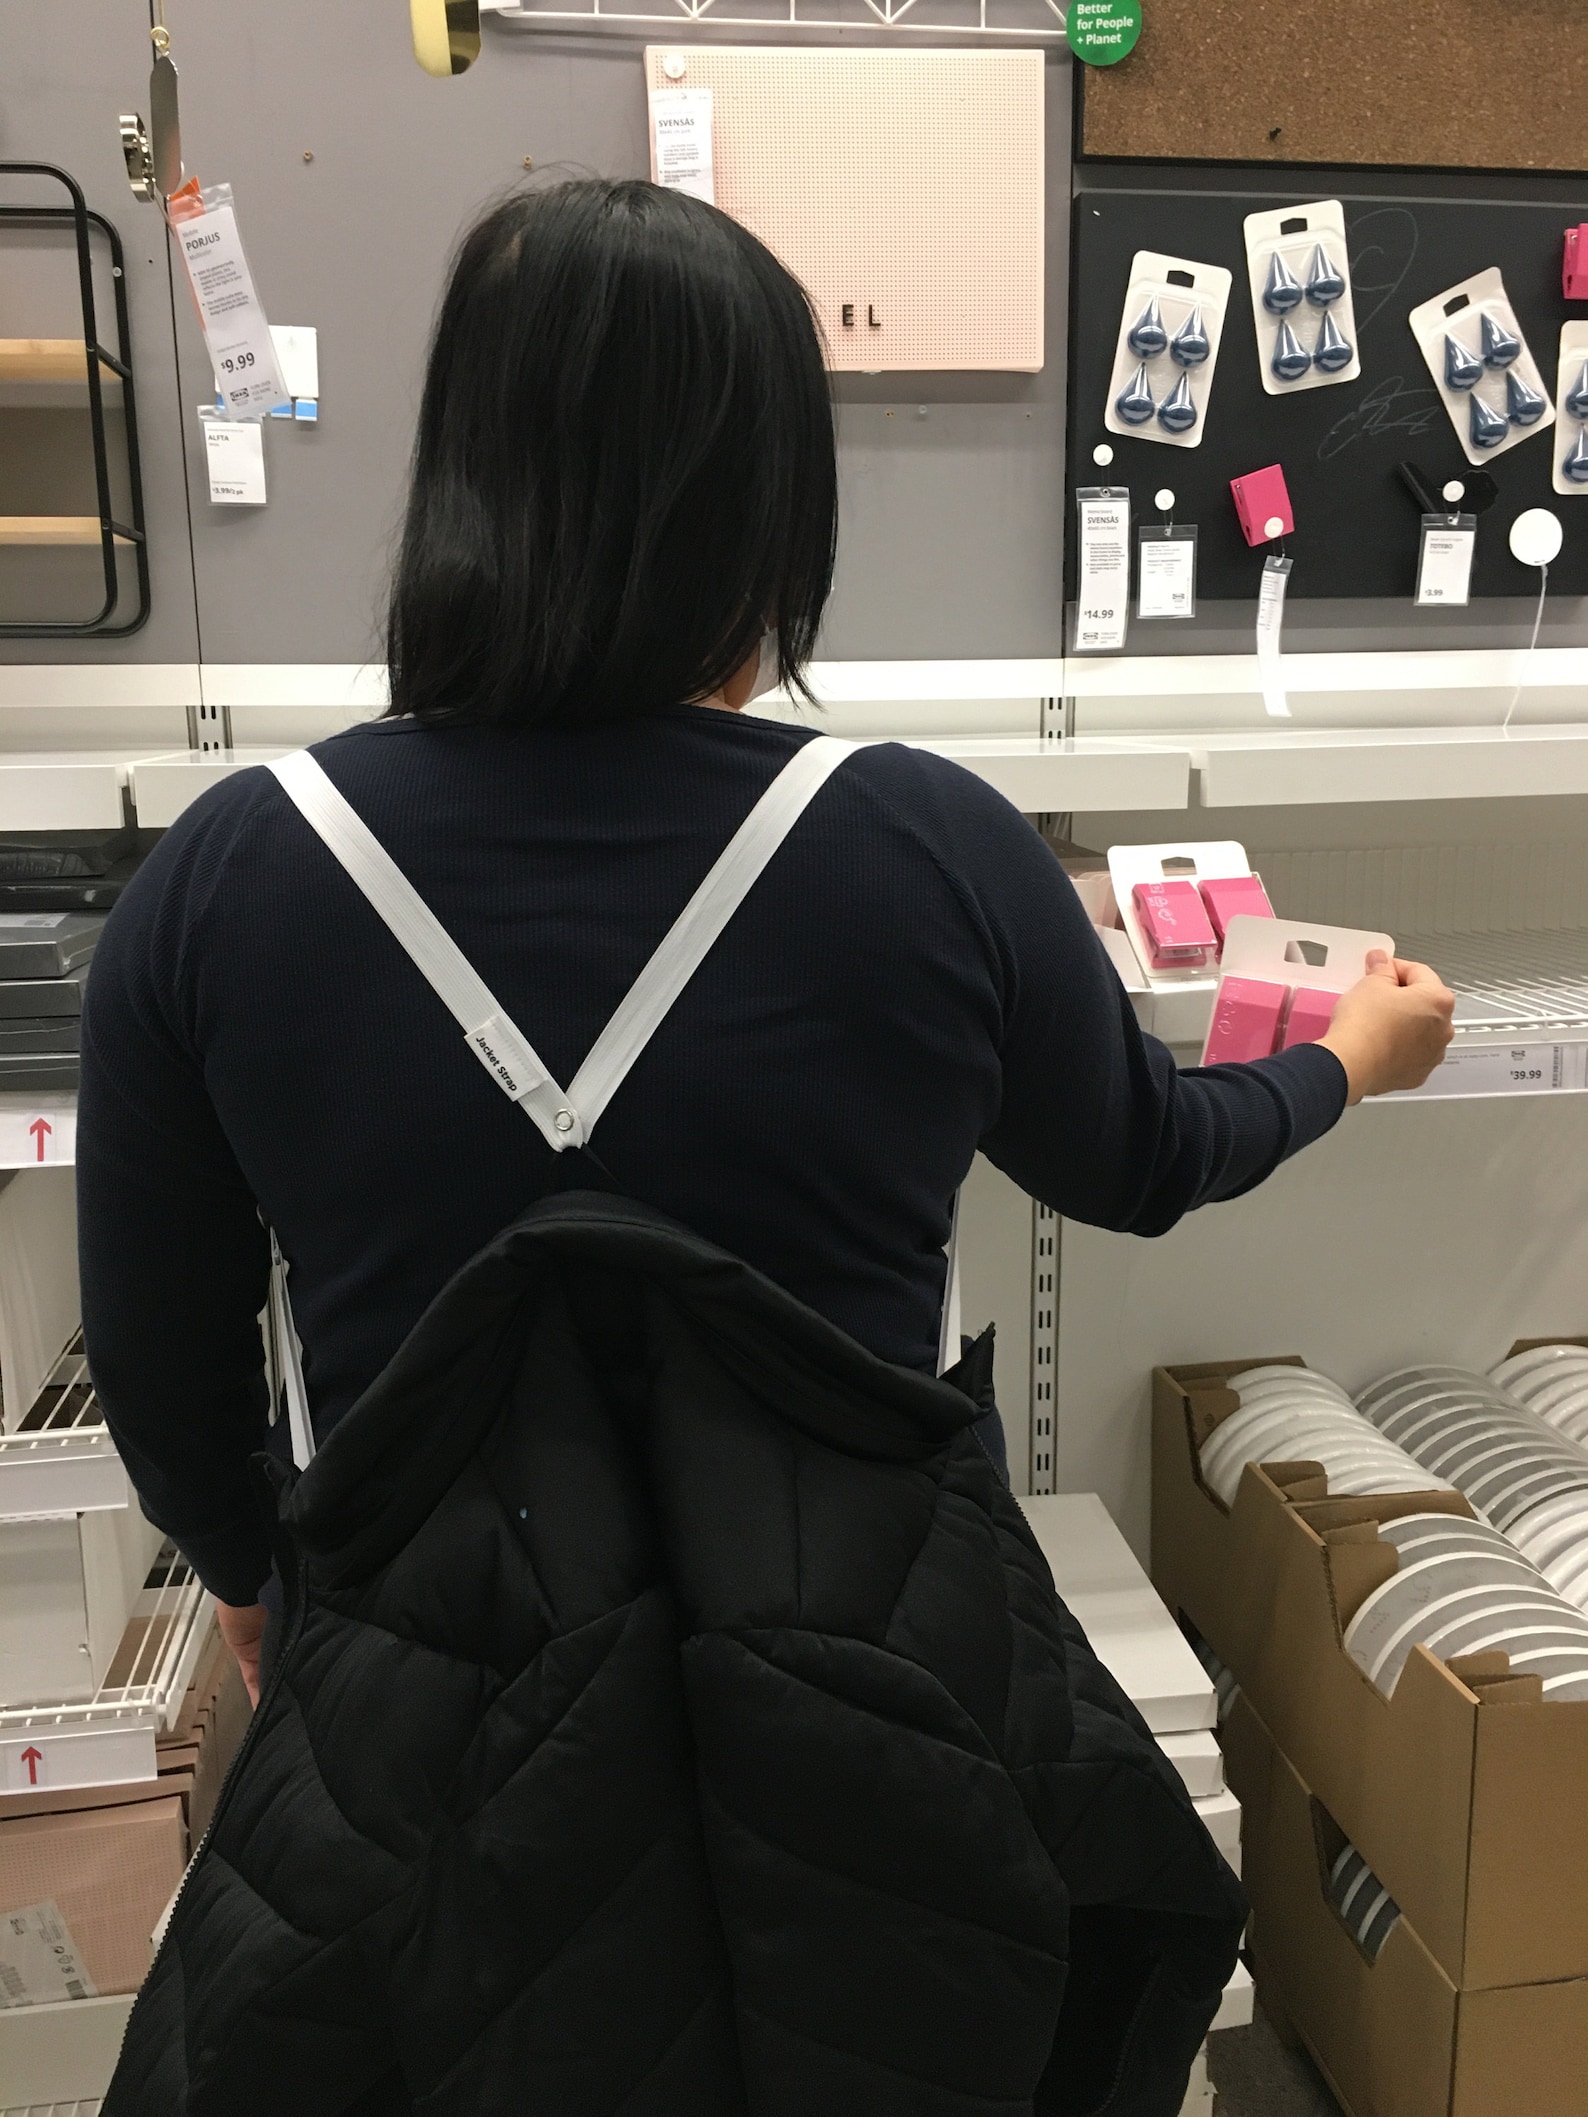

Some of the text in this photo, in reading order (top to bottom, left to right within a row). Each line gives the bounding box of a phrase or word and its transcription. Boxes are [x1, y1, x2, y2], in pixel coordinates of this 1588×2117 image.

[1077, 3, 1113, 15] Better
[1077, 16, 1134, 30] for People
[1086, 33, 1122, 45] Planet
[185, 231, 221, 251] PORJUS
[220, 352, 255, 373] $9.99
[476, 1037, 518, 1092] Jacket Strap
